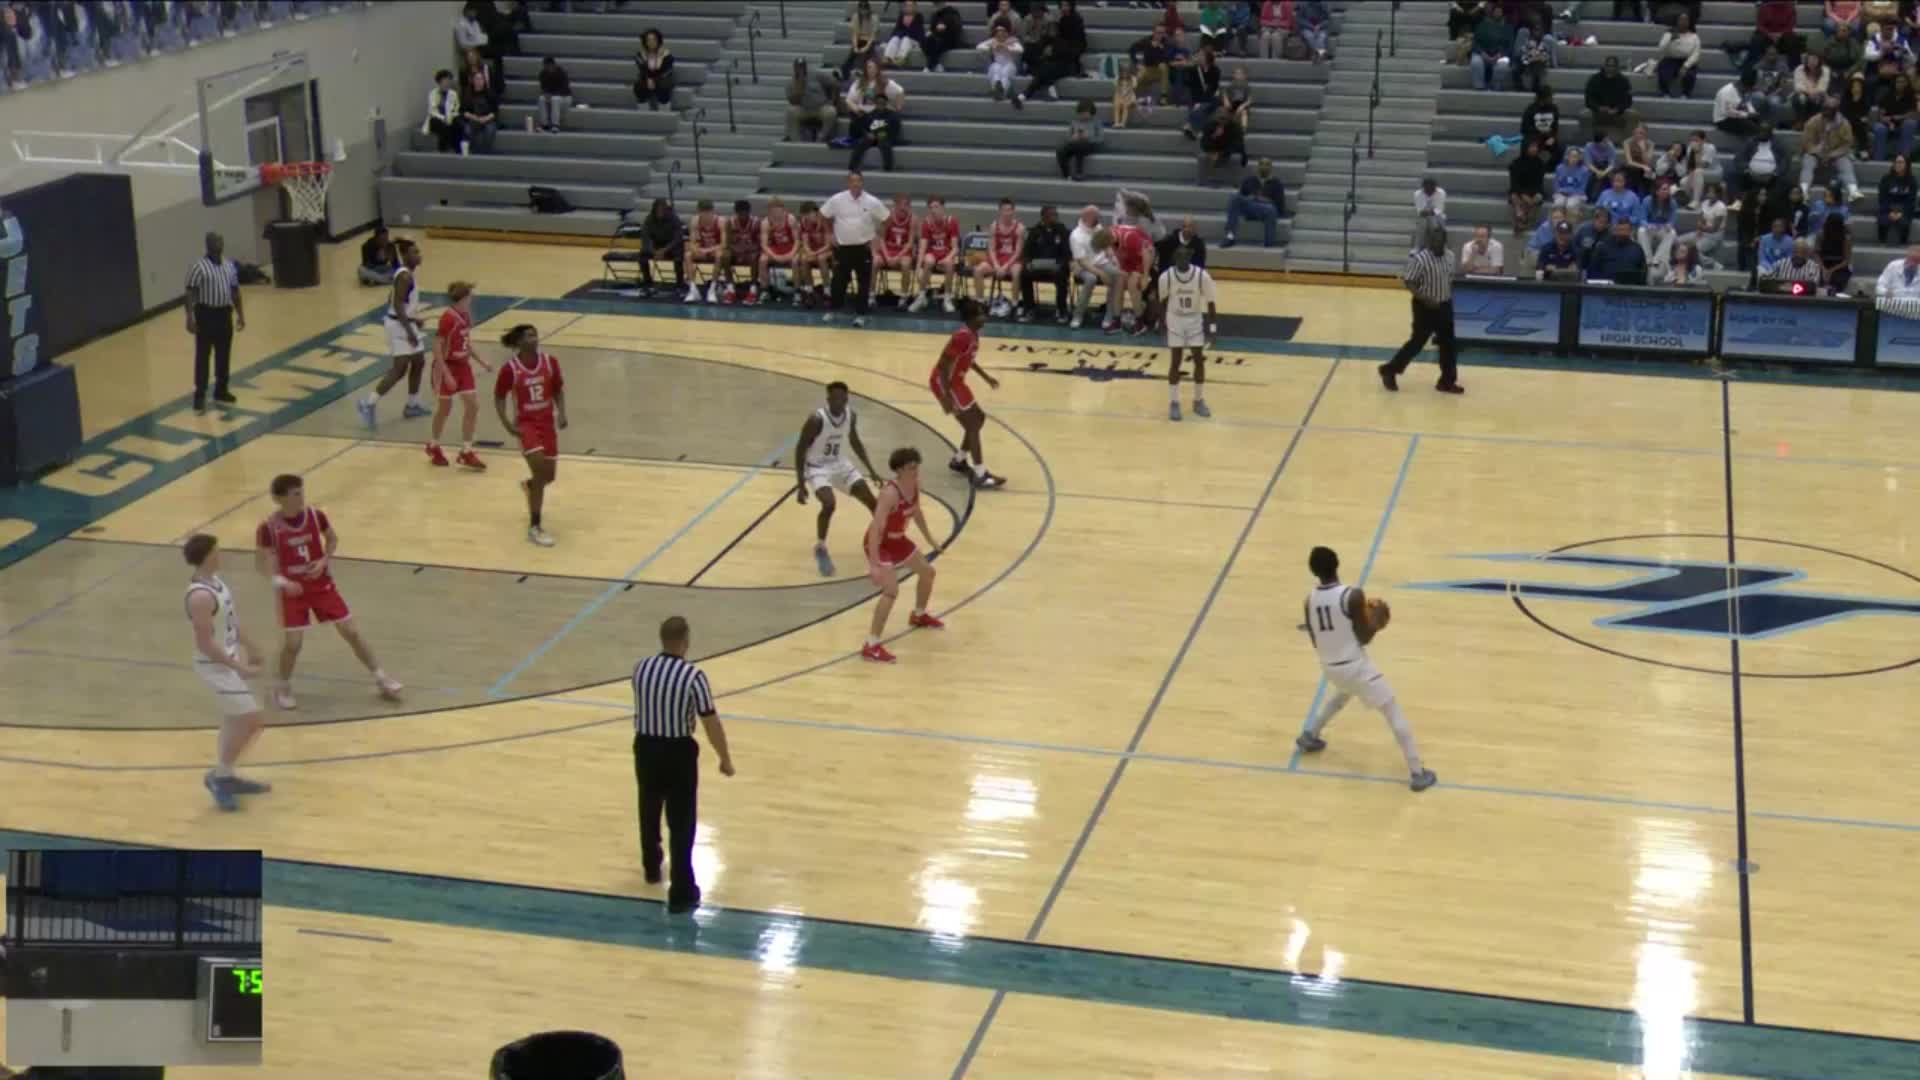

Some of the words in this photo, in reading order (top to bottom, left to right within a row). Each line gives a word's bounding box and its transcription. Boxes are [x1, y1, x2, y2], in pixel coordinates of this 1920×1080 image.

[1600, 333, 1632, 344] HIGH
[1633, 334, 1684, 347] SCHOOL
[529, 385, 545, 402] 12
[298, 545, 309, 562] 4
[1315, 604, 1335, 632] 11
